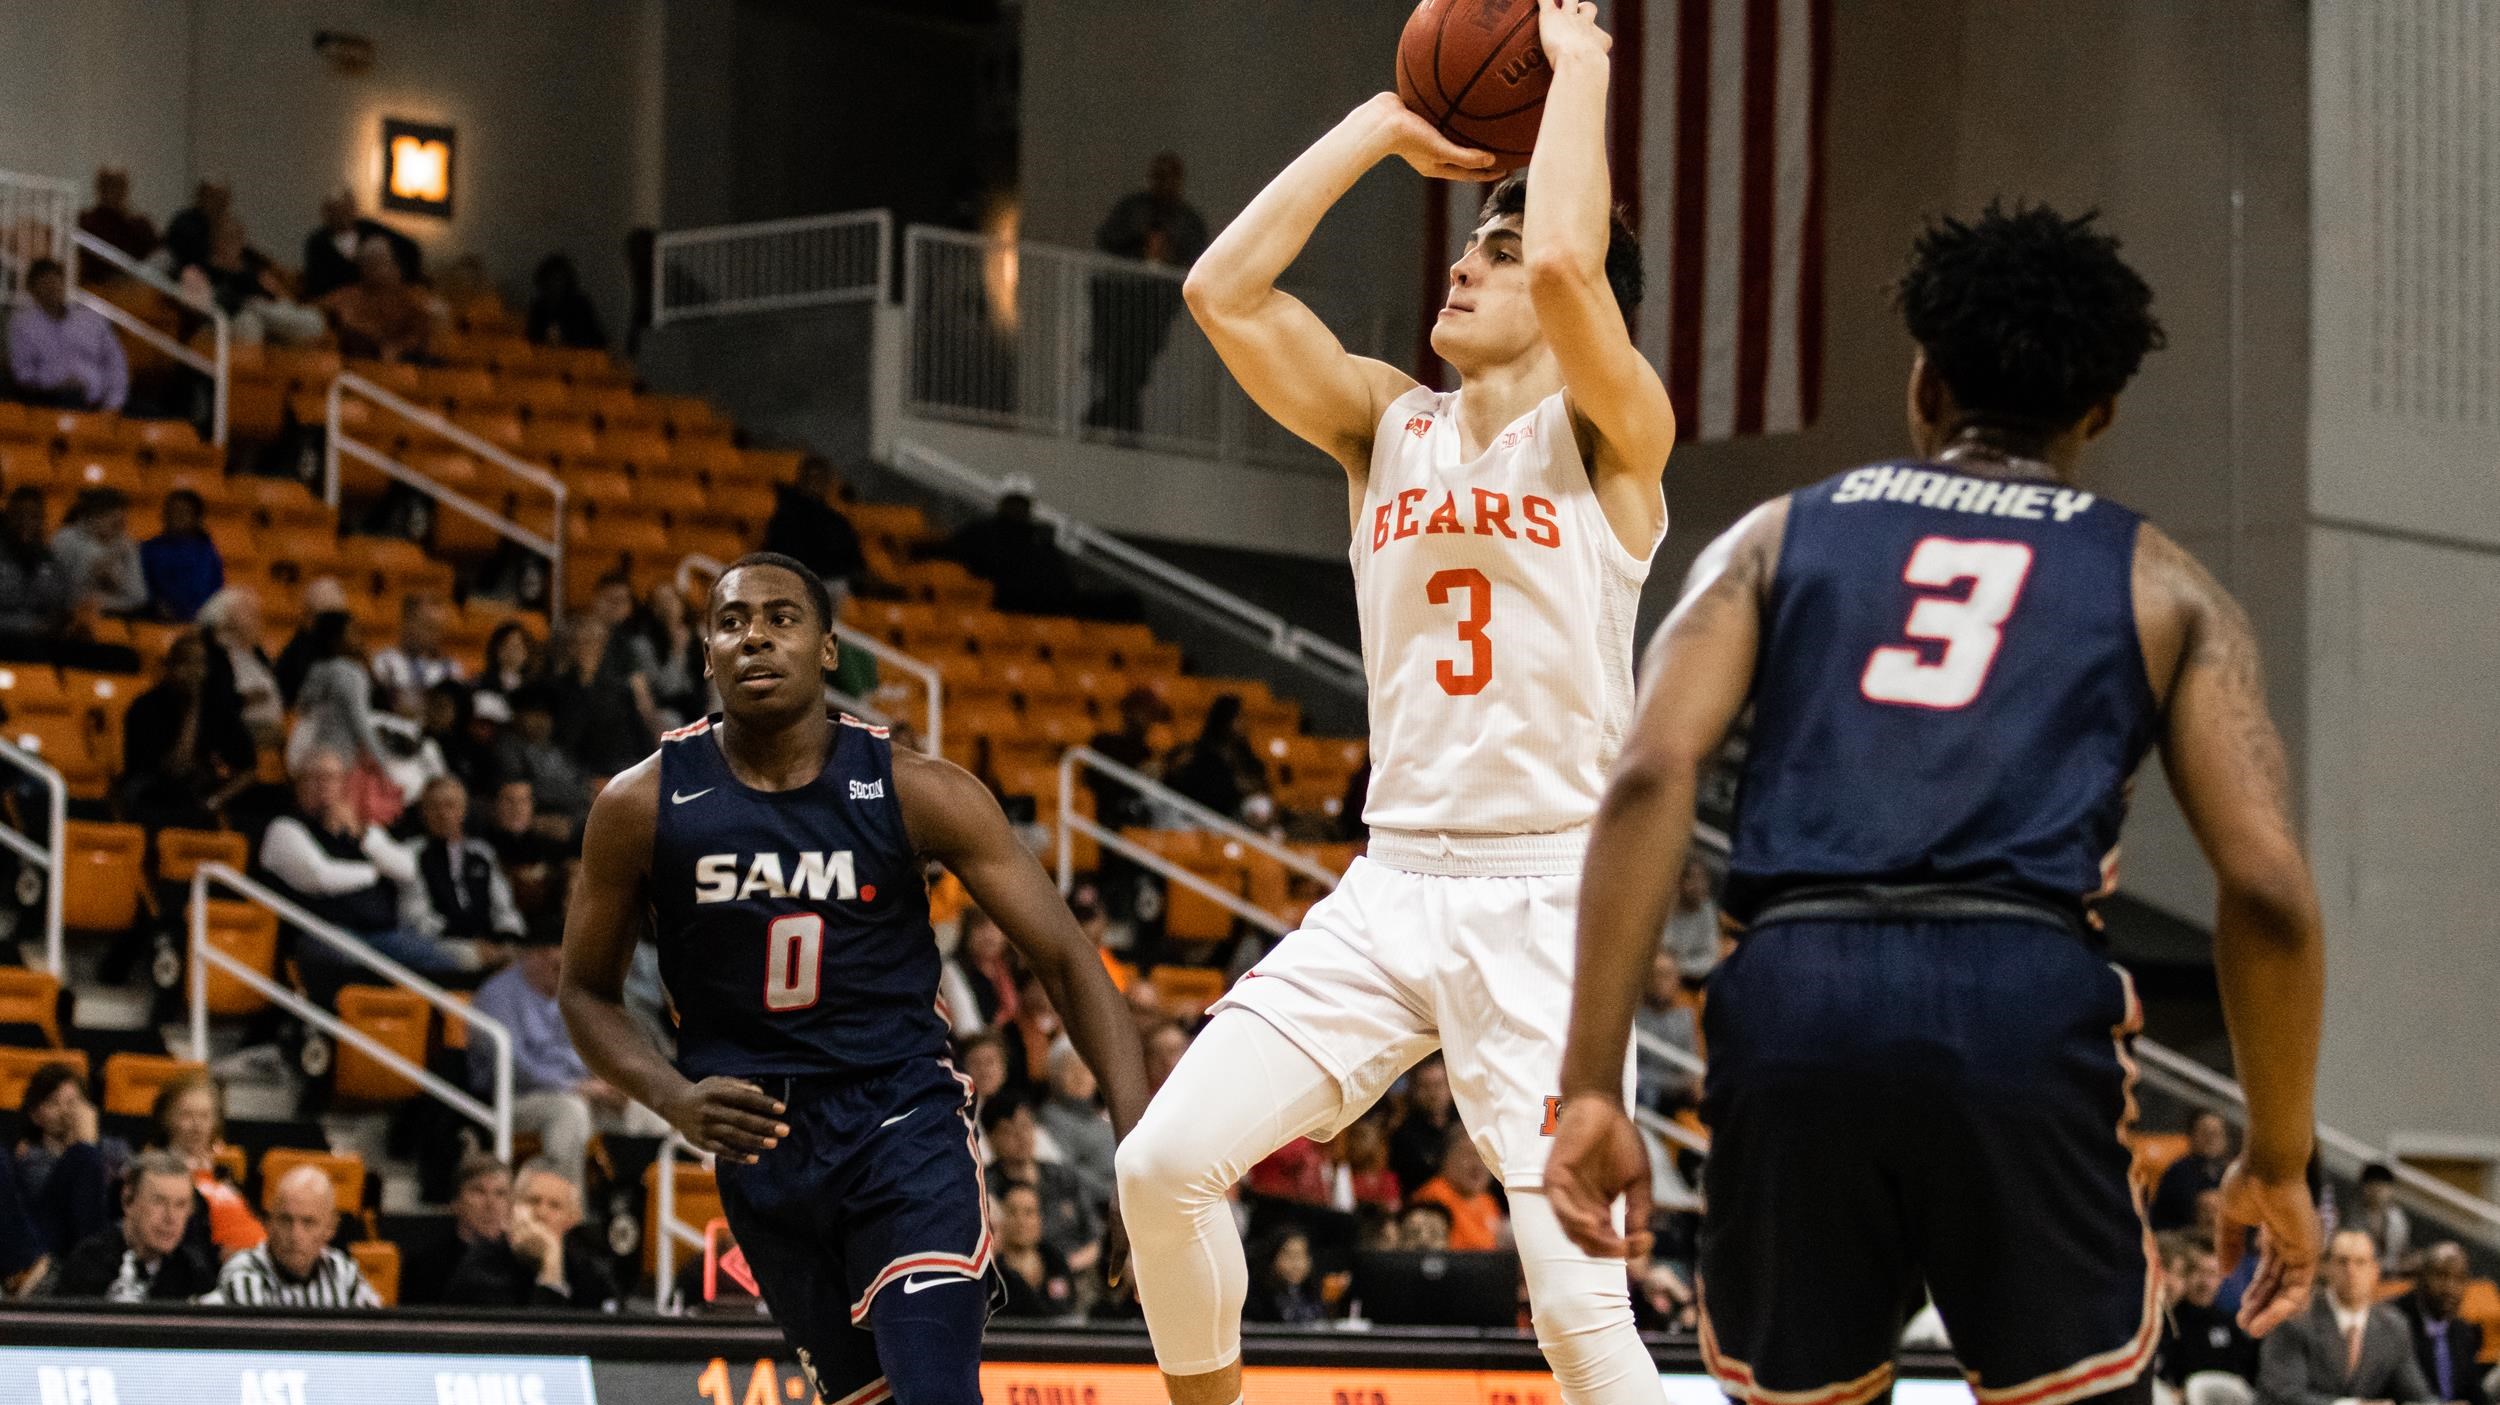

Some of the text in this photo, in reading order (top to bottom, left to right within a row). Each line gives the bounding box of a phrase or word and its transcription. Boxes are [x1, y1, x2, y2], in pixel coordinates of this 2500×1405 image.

[1373, 487, 1561, 554] BEARS
[1832, 465, 2096, 522] SHARKEY
[1426, 568, 1492, 696] 3
[1861, 534, 2035, 712] 3
[849, 777, 884, 800] SOCON
[763, 912, 825, 1013] 0
